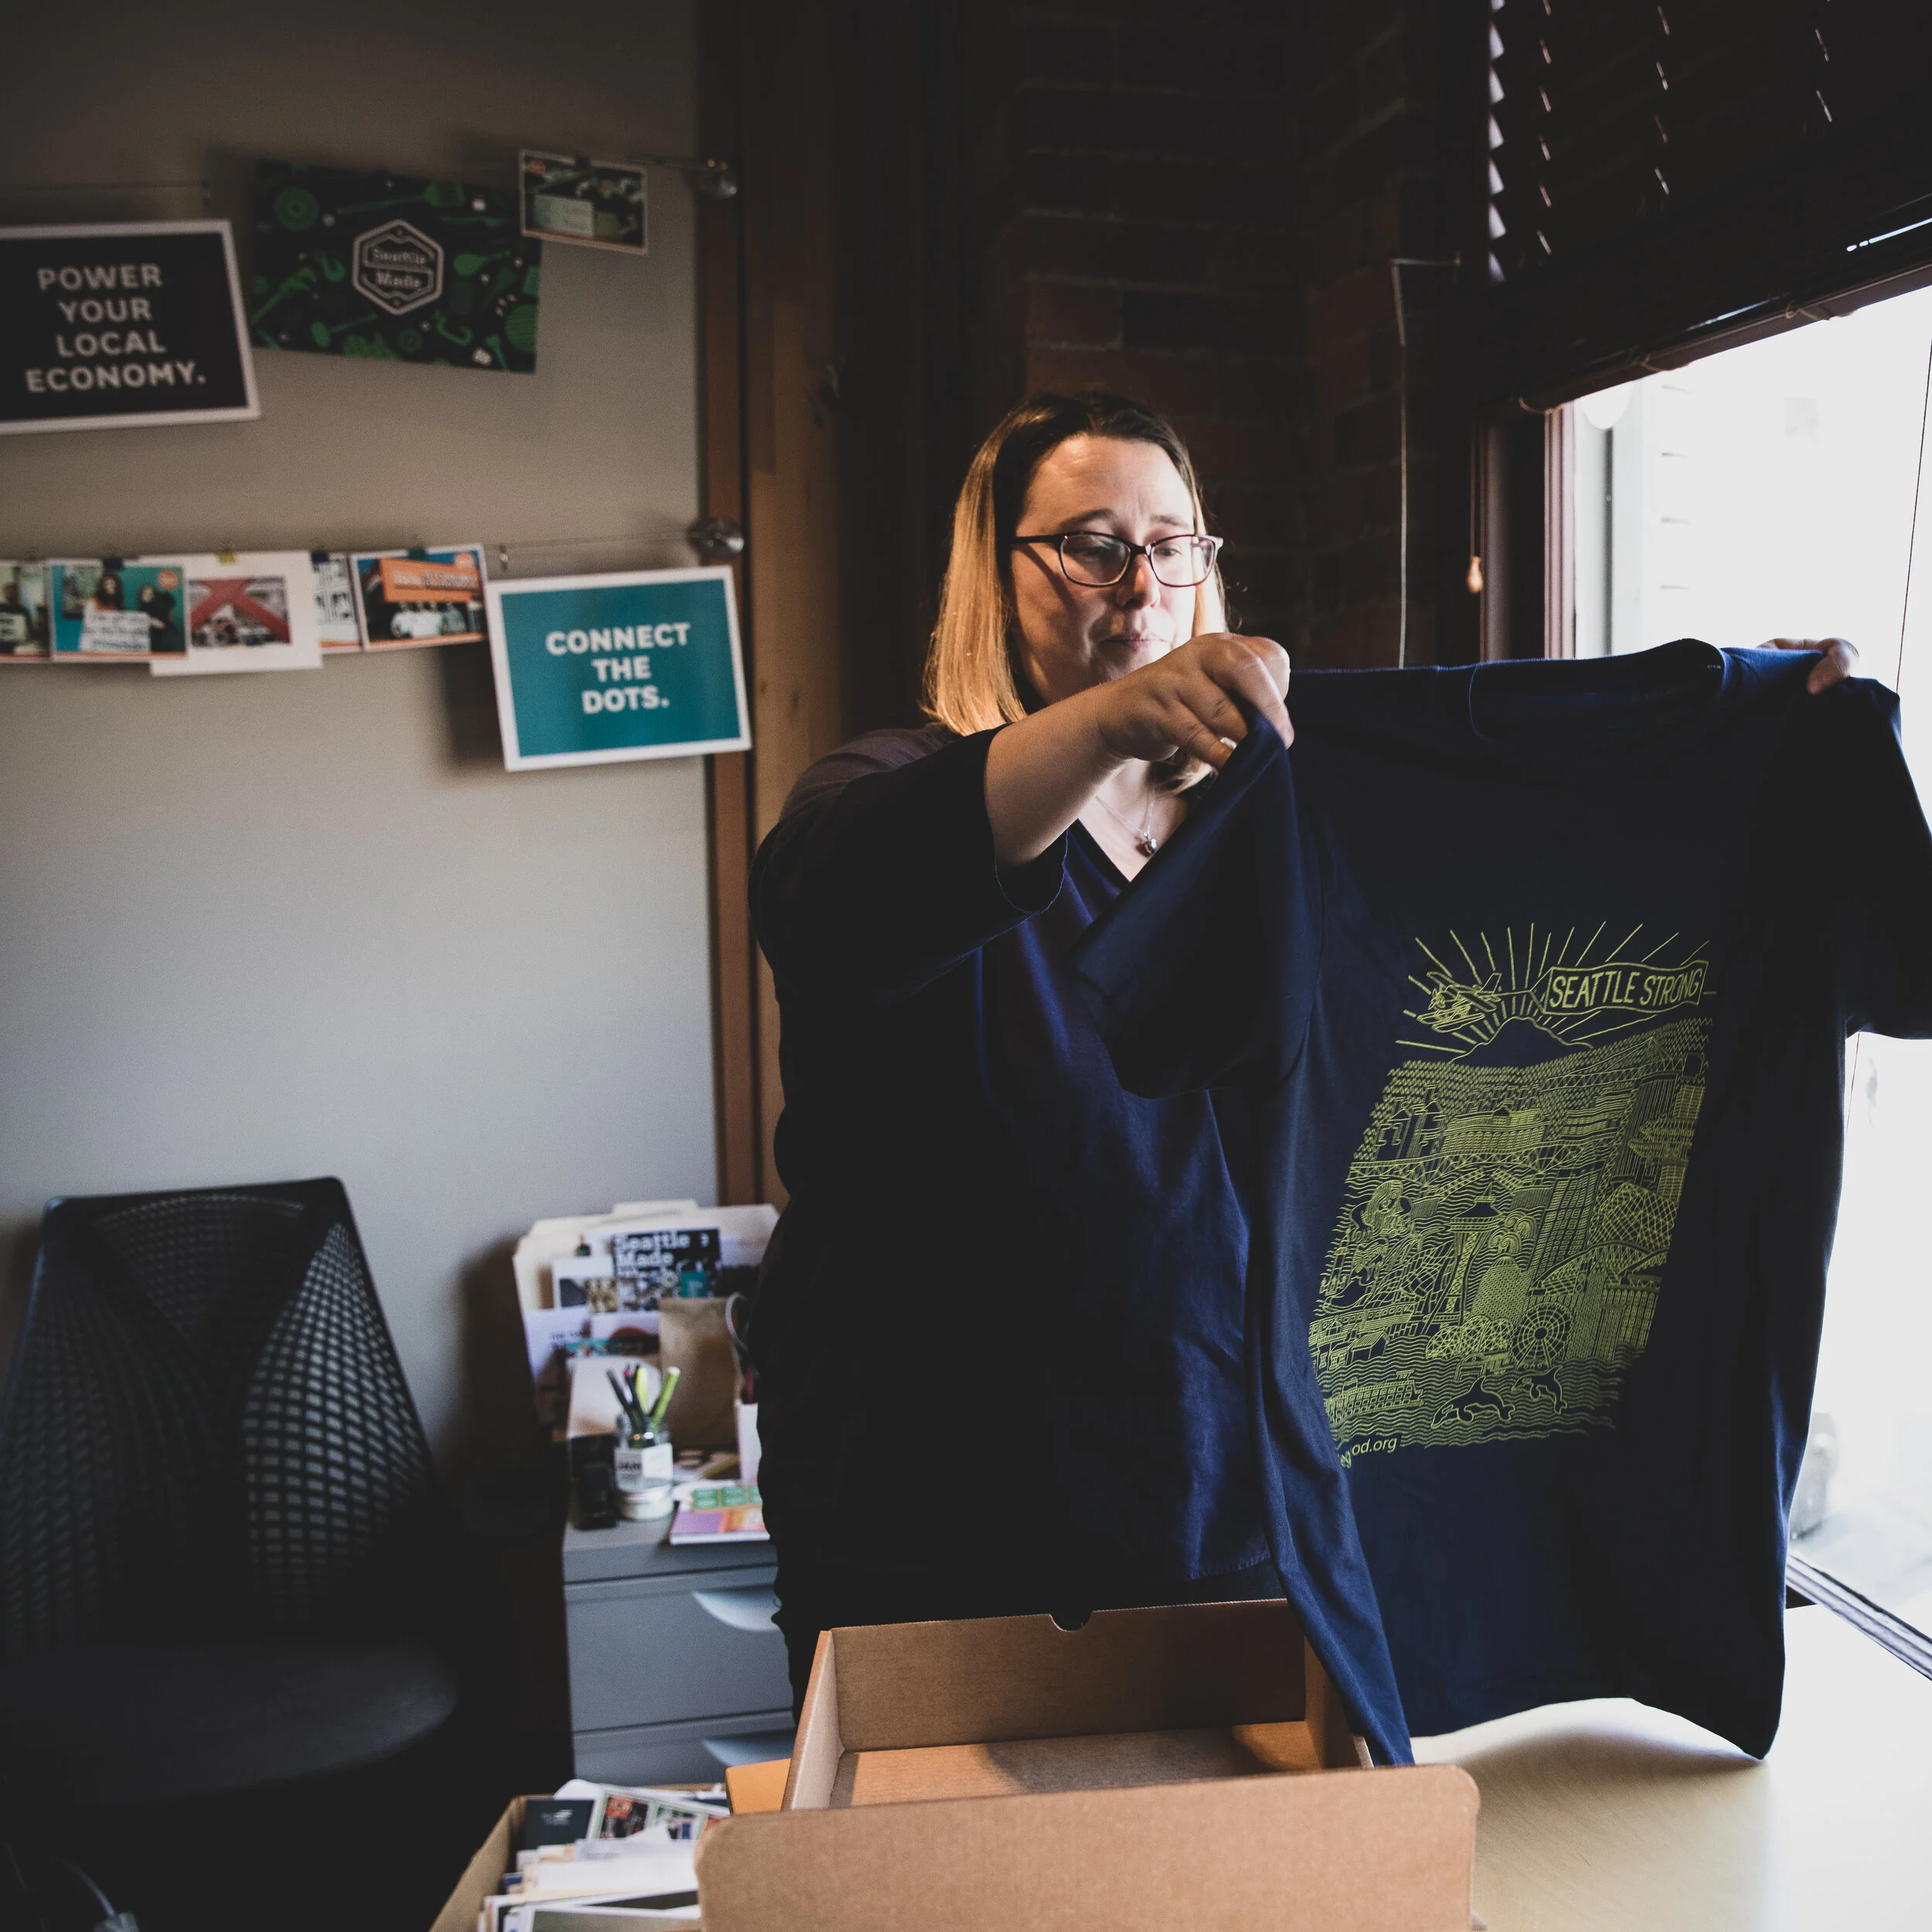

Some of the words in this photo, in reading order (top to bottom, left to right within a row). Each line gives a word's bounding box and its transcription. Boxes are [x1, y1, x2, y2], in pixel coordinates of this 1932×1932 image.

[38, 264, 162, 291] POWER
[58, 297, 152, 324] YOUR
[56, 329, 167, 358] LOCAL
[25, 359, 207, 393] ECONOMY.
[546, 621, 691, 655] CONNECT
[590, 655, 652, 682] THE
[581, 685, 670, 715] DOTS.
[1549, 971, 1641, 1009] SEATTLE
[1639, 968, 1703, 1007] STRONG
